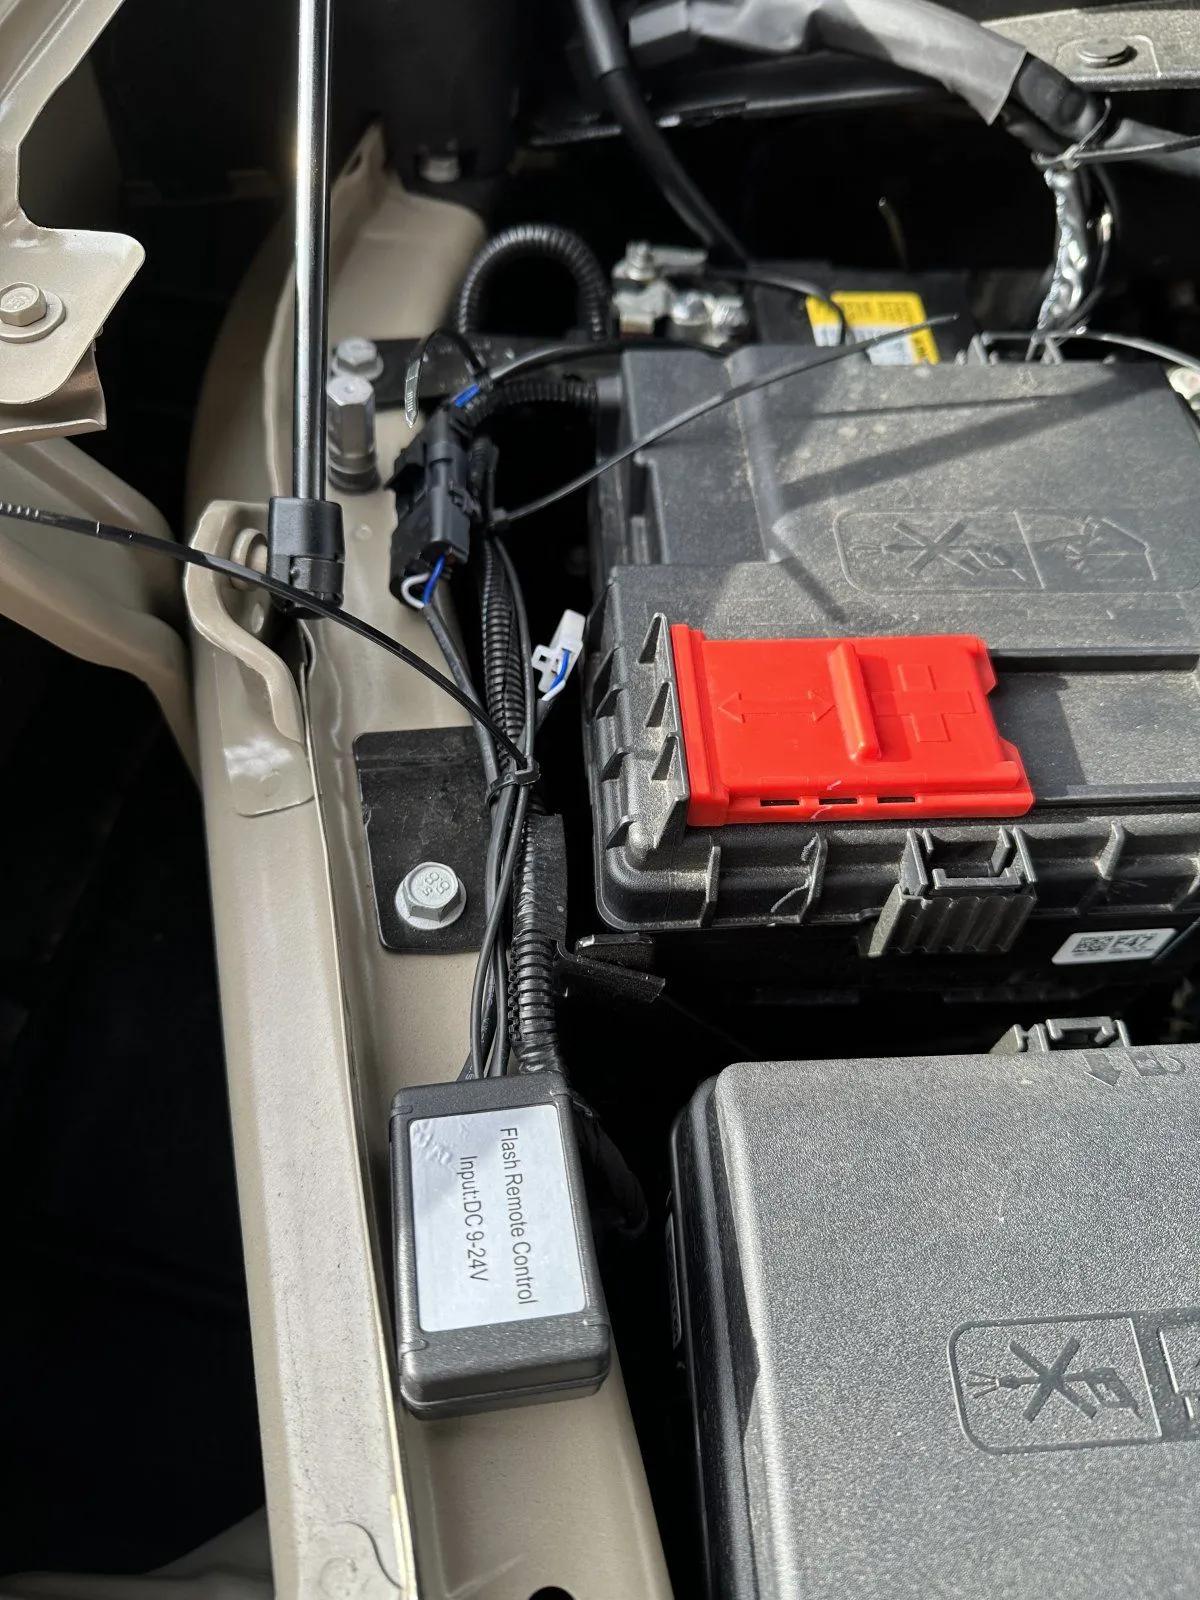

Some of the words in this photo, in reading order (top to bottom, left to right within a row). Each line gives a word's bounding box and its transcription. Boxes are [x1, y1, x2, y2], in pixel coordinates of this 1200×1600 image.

[499, 1127, 522, 1170] Flash
[456, 1155, 484, 1227] Input:DC
[504, 1173, 528, 1238] Remote
[465, 1230, 490, 1281] 9-24V
[512, 1241, 540, 1305] Control
